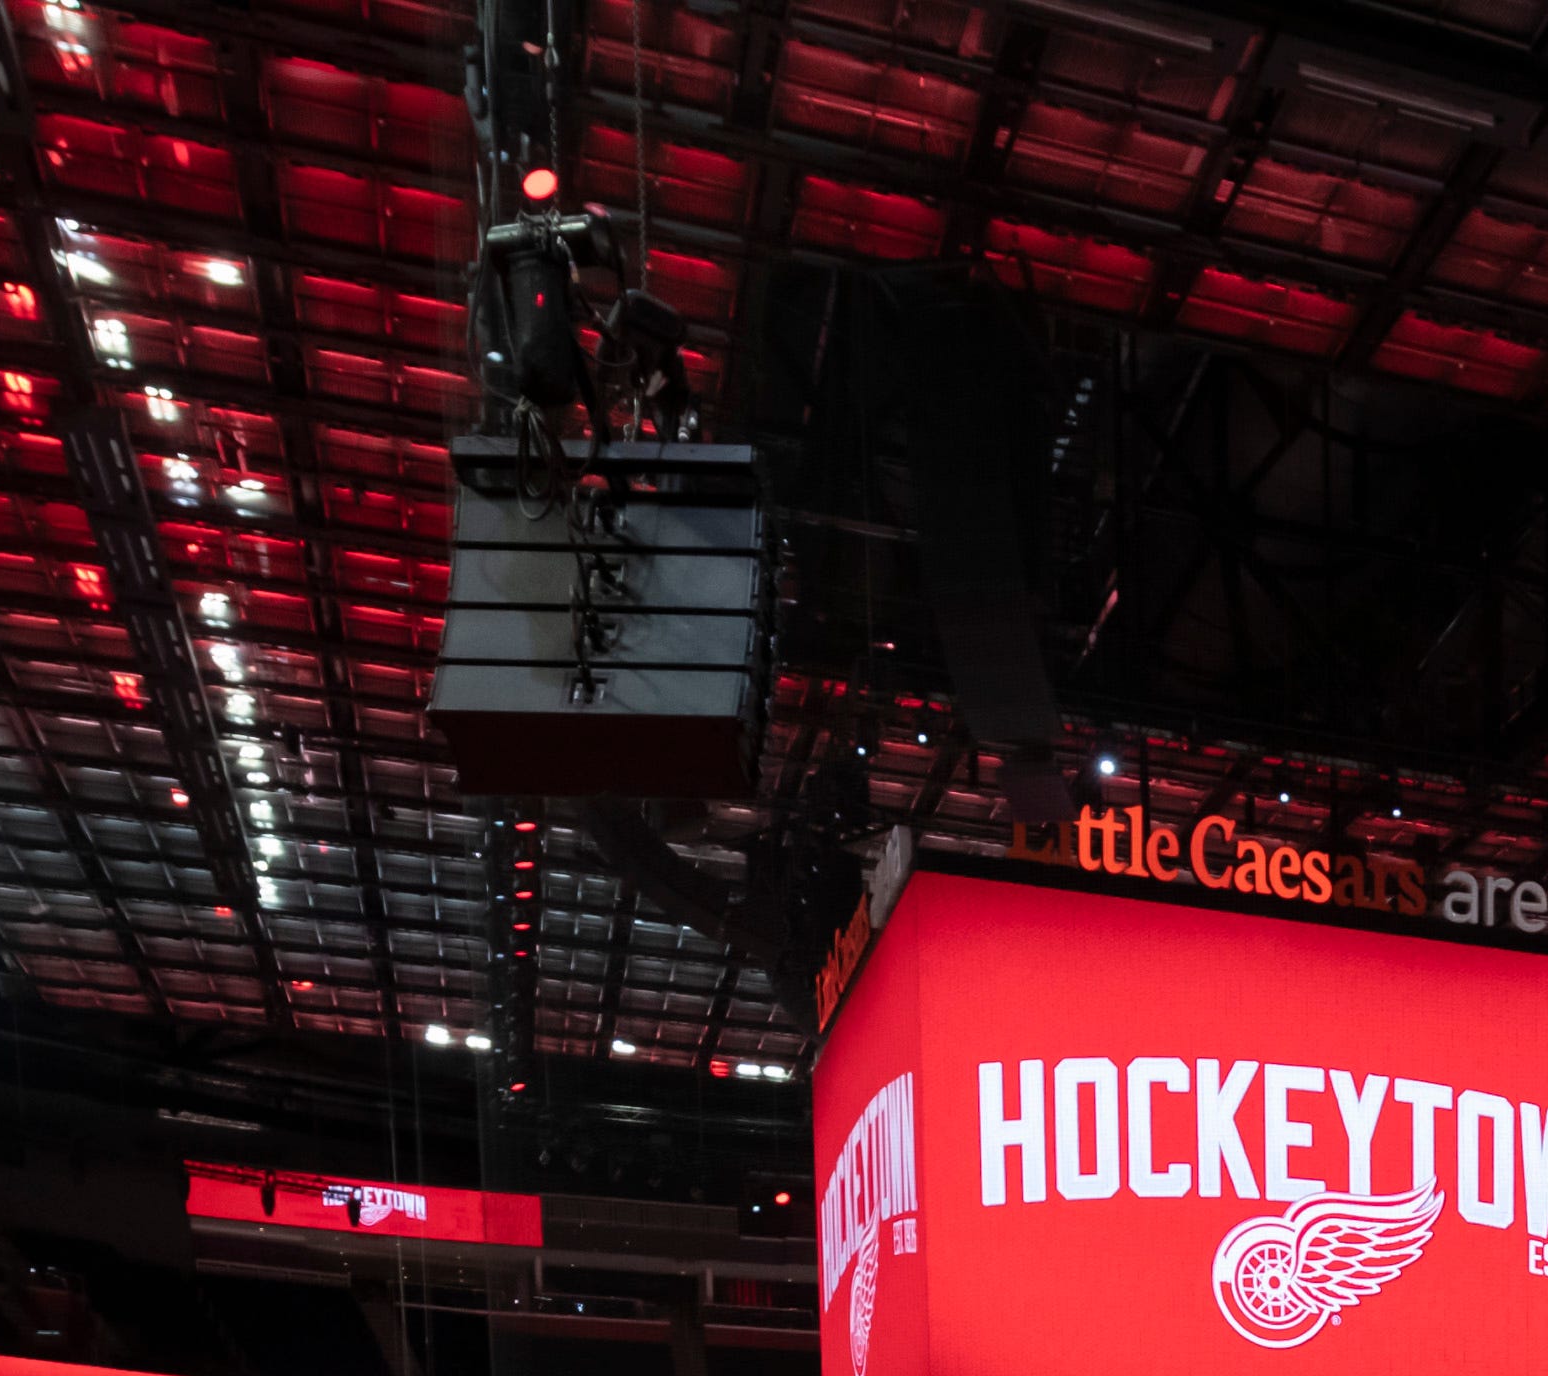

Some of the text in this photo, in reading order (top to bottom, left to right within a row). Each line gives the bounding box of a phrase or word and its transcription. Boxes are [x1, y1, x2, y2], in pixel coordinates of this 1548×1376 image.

[1006, 803, 1180, 881] Little
[1190, 815, 1426, 916] Caesars
[821, 1072, 918, 1313] HOCKEYTOWN
